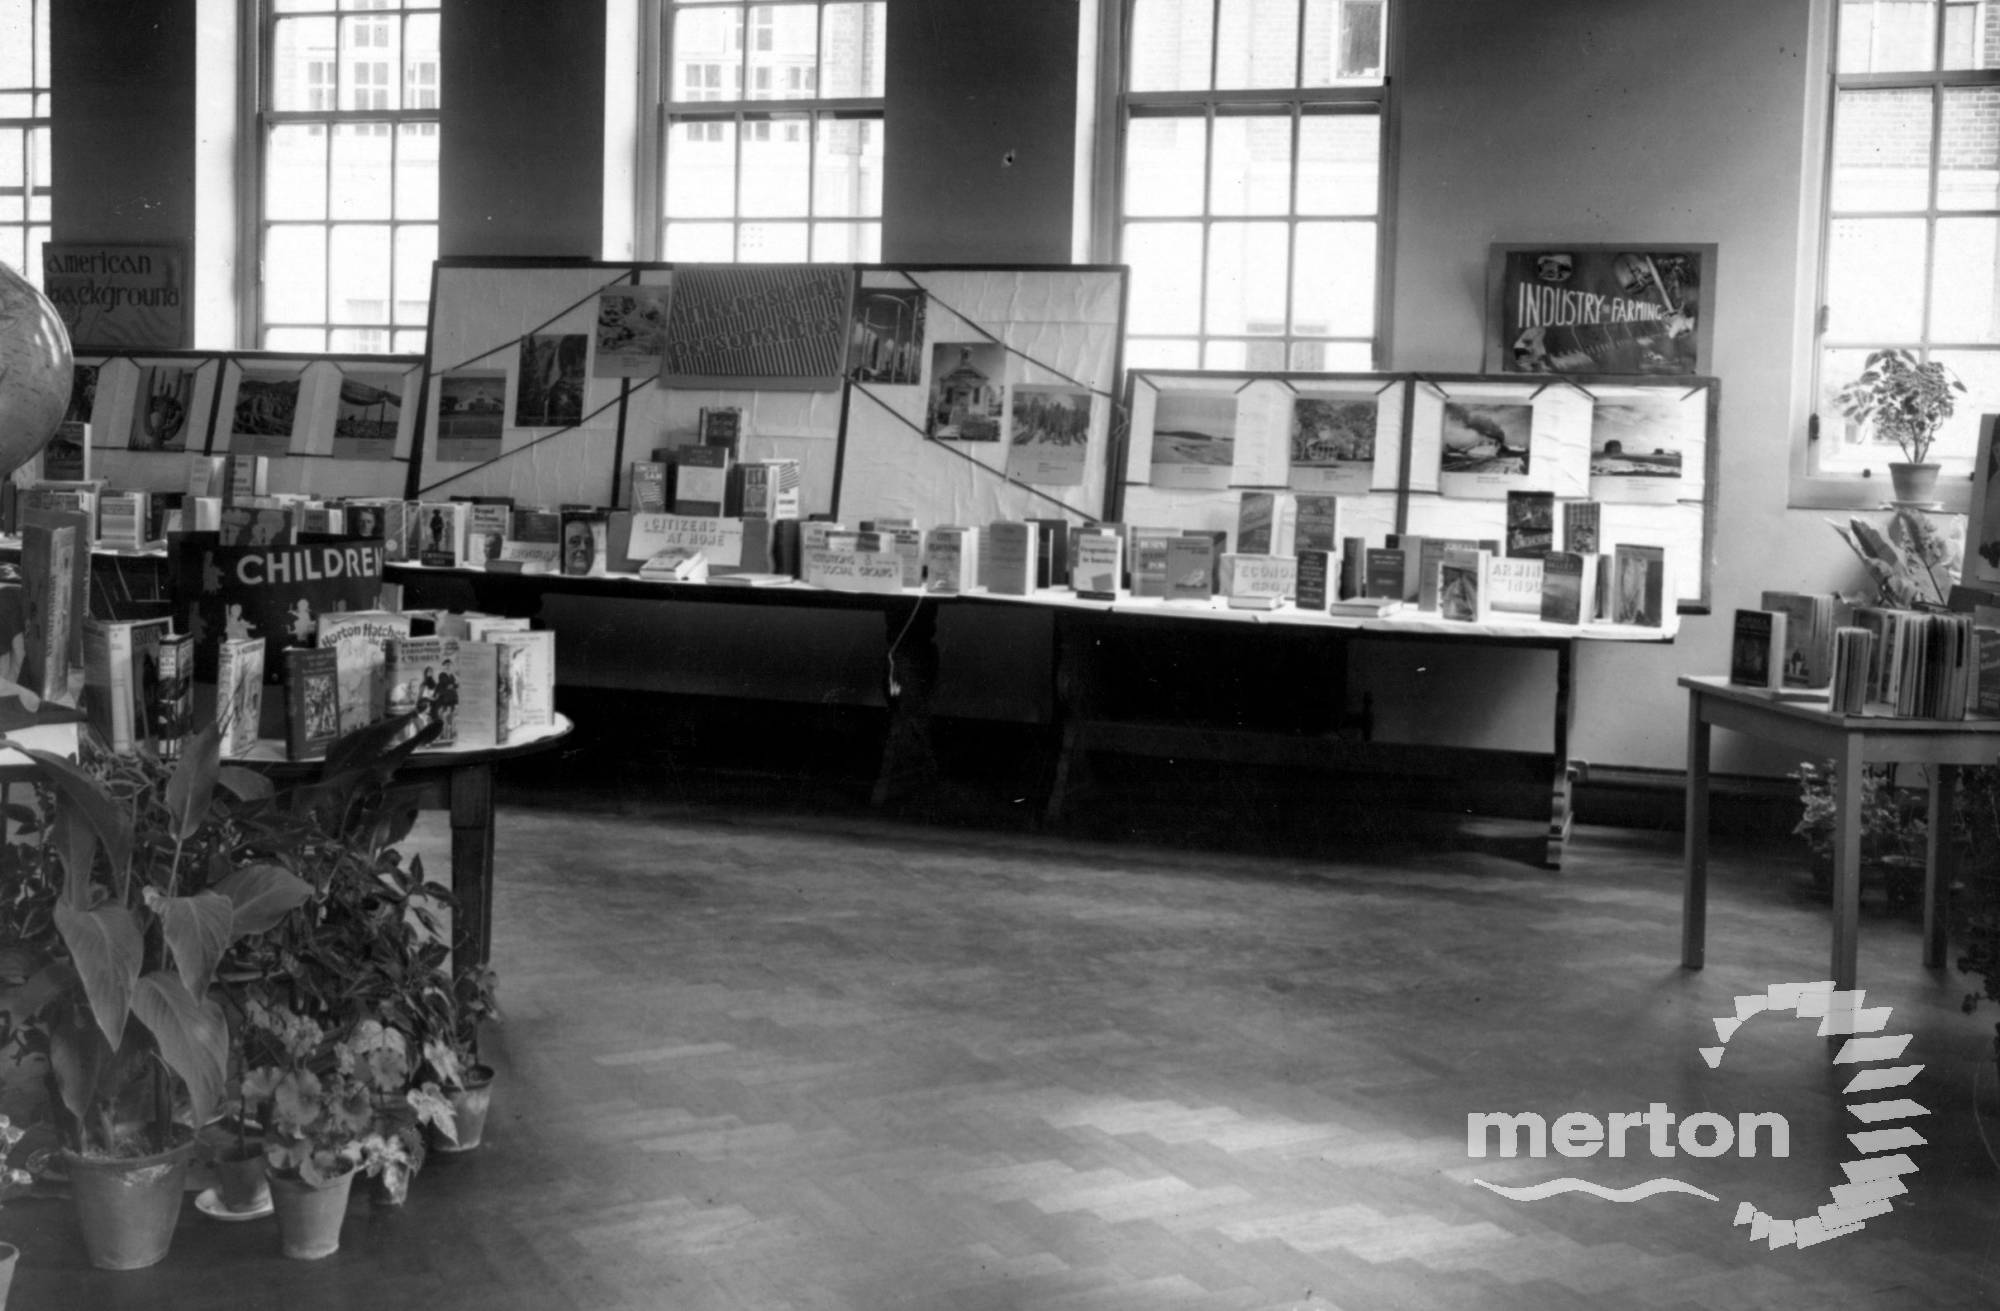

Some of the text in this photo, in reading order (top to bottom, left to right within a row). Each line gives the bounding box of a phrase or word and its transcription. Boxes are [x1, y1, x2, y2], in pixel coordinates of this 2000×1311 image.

[46, 250, 152, 275] american
[49, 279, 180, 312] background
[1518, 282, 1606, 328] INDUSTRY
[1611, 297, 1662, 323] FARMING
[236, 547, 383, 585] CHILDREN
[321, 626, 362, 648] Horton
